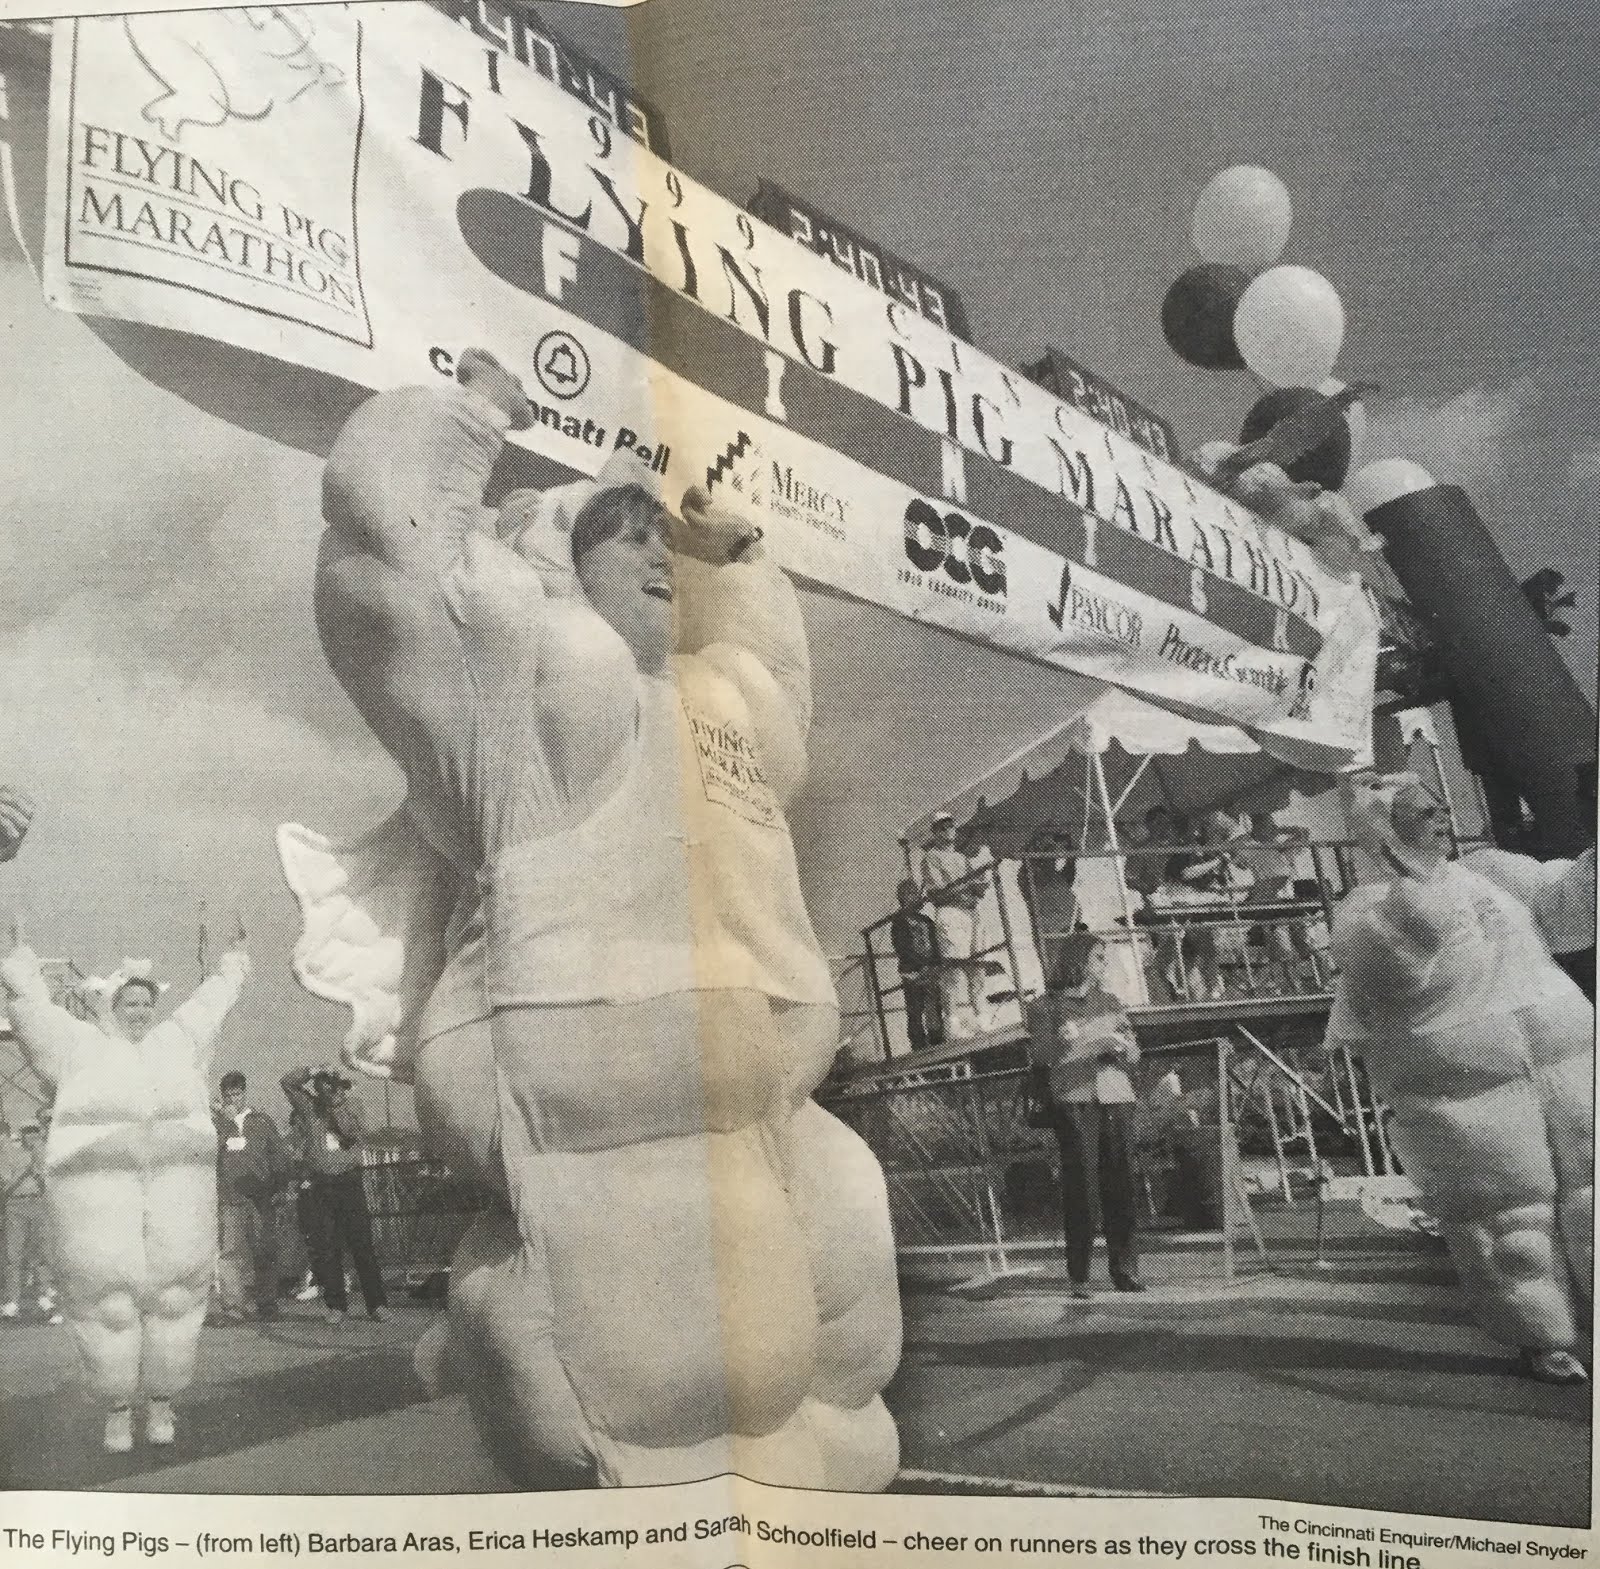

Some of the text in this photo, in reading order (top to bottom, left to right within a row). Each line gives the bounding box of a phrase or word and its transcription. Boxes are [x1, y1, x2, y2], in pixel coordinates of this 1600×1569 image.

[79, 186, 356, 309] MARATHON
[80, 123, 352, 269] FLYING PIG
[408, 62, 1320, 622] FLYING PIG MARATHON
[3, 1529, 45, 1549] The
[52, 1530, 115, 1556] Flying
[122, 1532, 169, 1557] Pigs
[196, 1533, 253, 1558] (from
[260, 1532, 300, 1557] left)
[308, 1531, 397, 1553] Barbara
[403, 1531, 461, 1553] Aras,
[469, 1530, 525, 1550] Erica
[532, 1528, 639, 1549] Heskamp
[646, 1522, 687, 1544] and
[694, 1514, 751, 1540] Sarah
[757, 1521, 877, 1550] Schoolfield
[904, 1531, 966, 1552] cheer
[975, 1537, 1002, 1552] on
[1010, 1538, 1097, 1554] runners
[1104, 1540, 1132, 1555] as
[1138, 1536, 1187, 1560] they
[1194, 1540, 1257, 1556] cross
[1263, 1537, 1300, 1559] the
[1307, 1542, 1370, 1567] finish
[1379, 1549, 1421, 1569] line
[1258, 1516, 1588, 1561] The Cincinnati Enquirer/Michael Snyder
